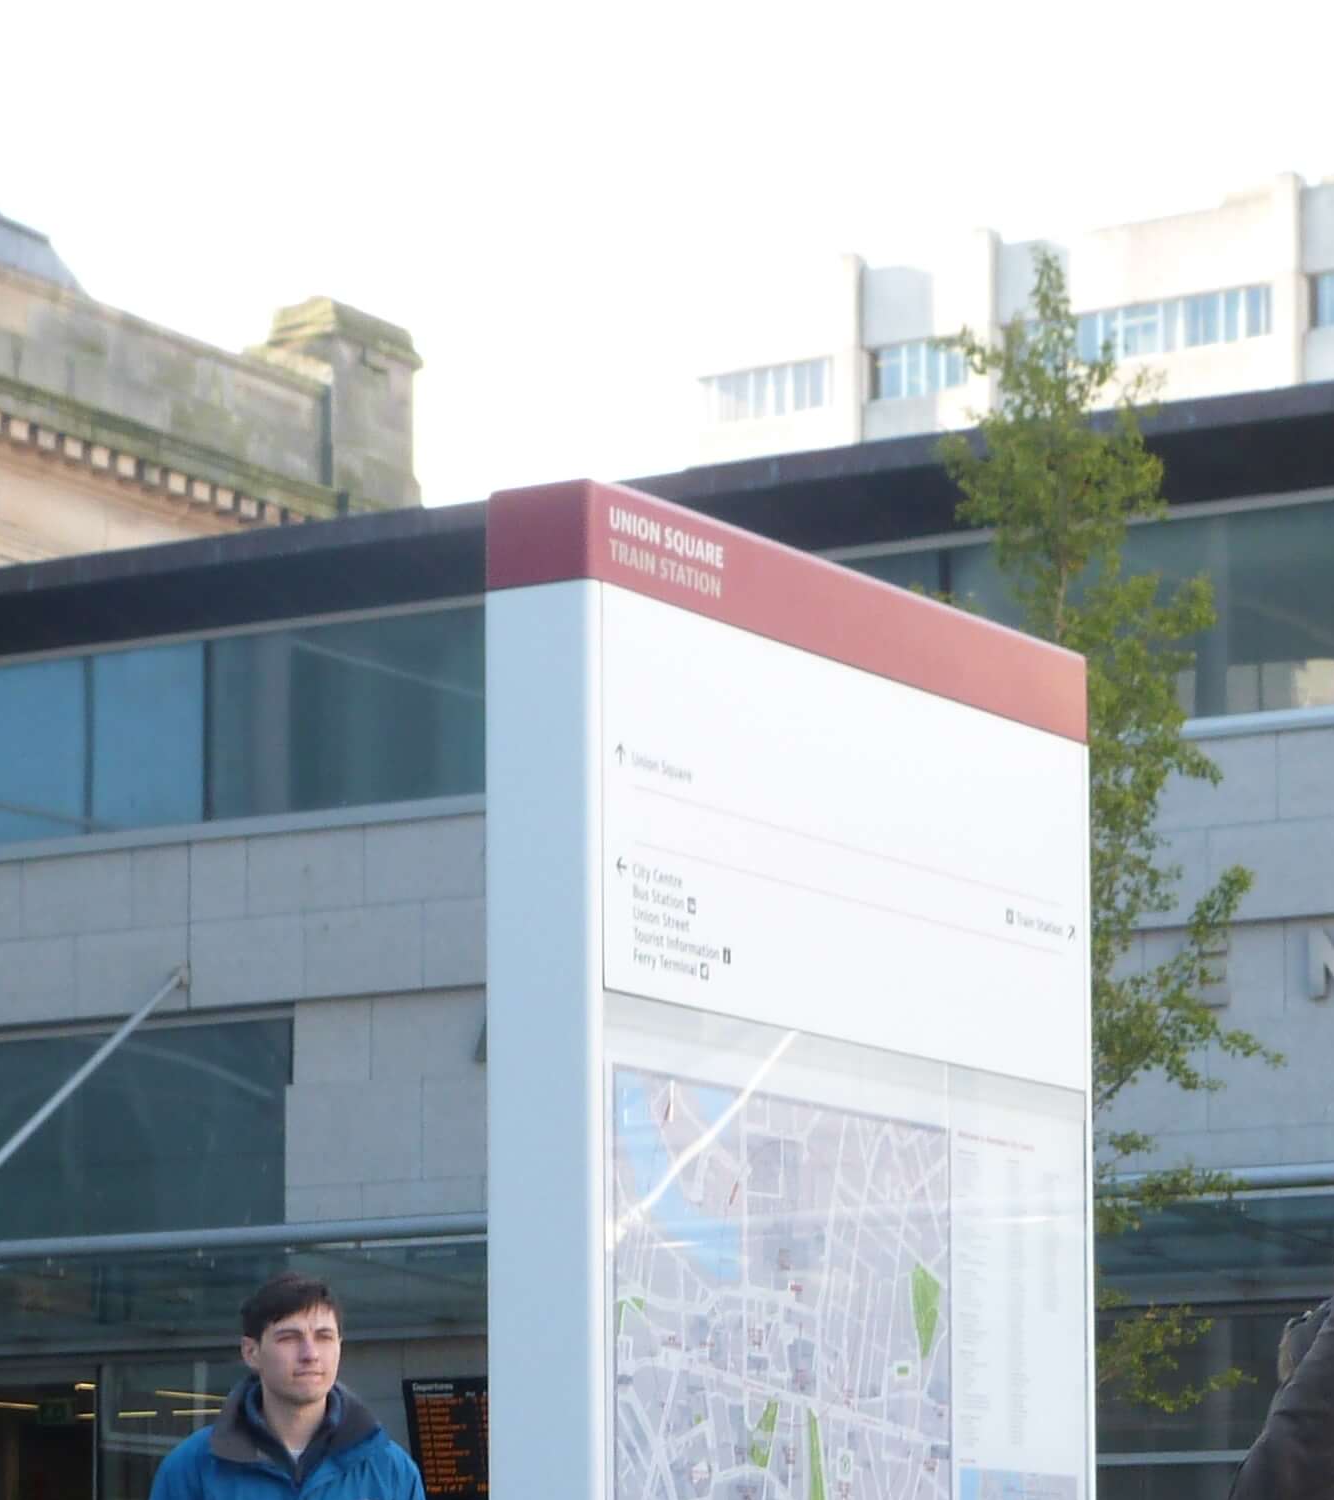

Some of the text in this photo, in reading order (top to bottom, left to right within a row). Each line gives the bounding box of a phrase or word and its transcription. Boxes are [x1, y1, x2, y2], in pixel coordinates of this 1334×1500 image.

[609, 505, 724, 569] UNION SQUARE
[609, 538, 722, 600] TRAIN STATION
